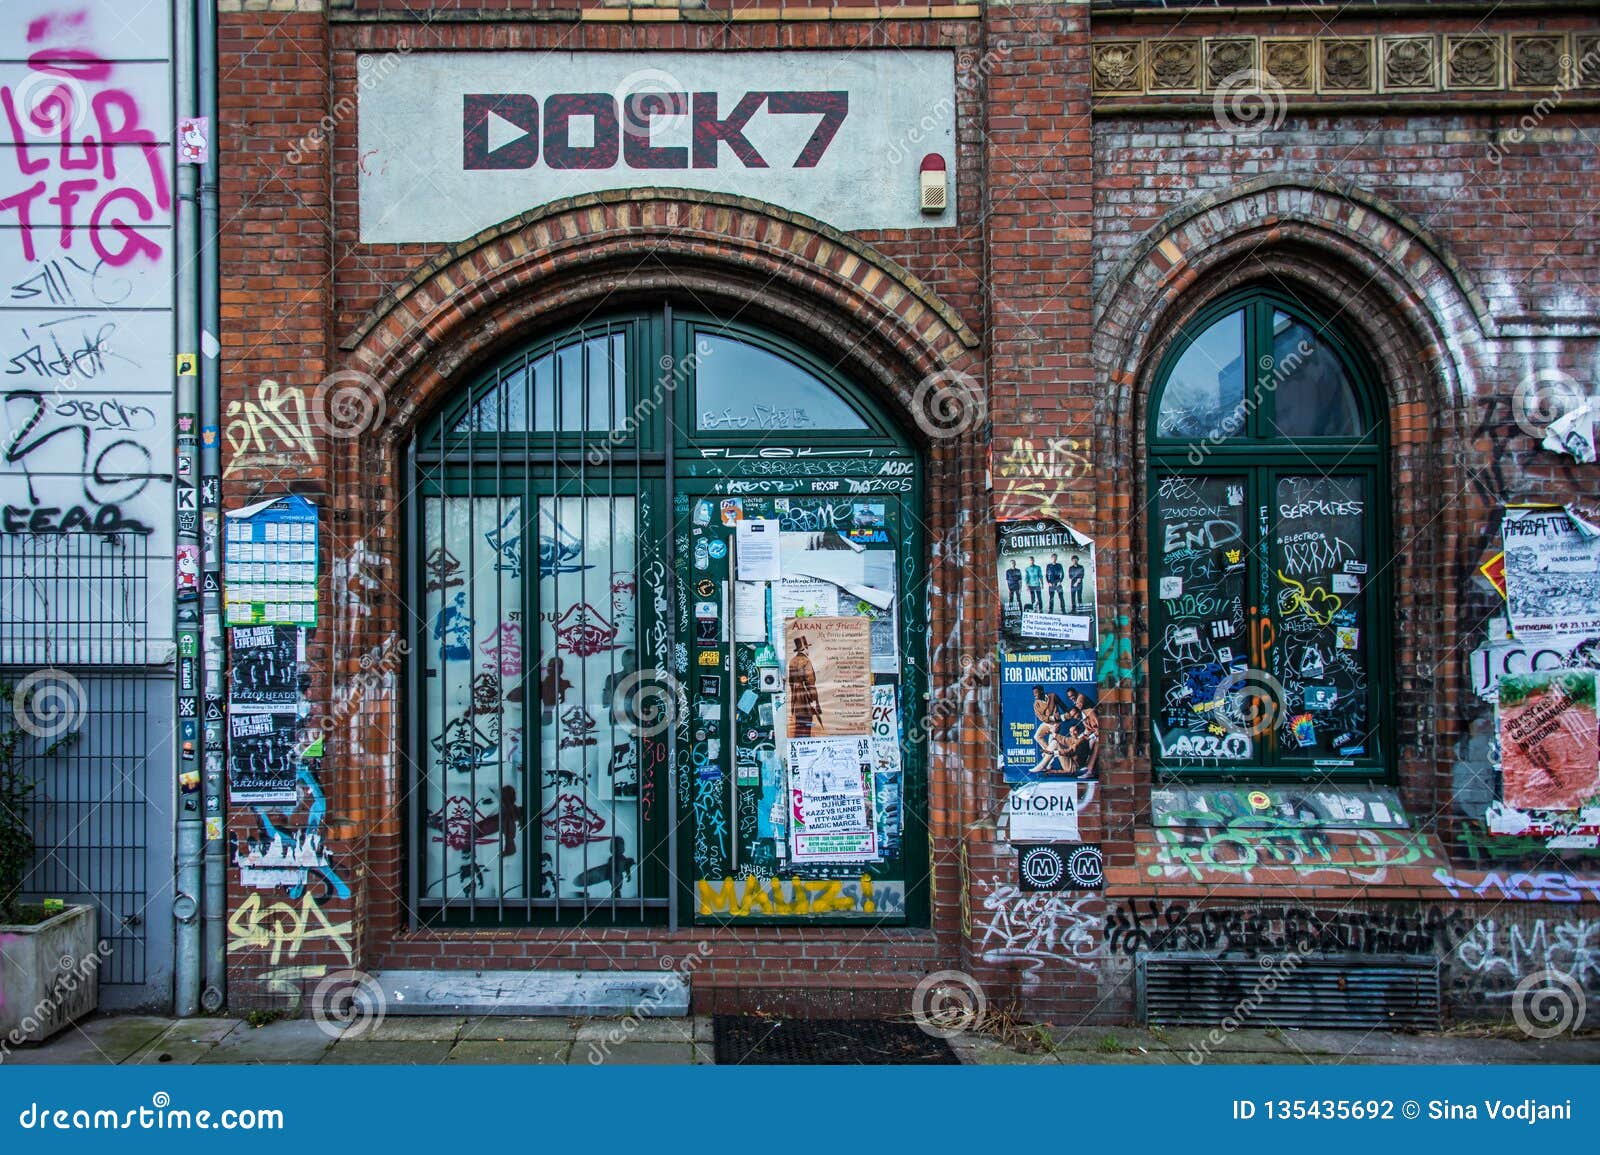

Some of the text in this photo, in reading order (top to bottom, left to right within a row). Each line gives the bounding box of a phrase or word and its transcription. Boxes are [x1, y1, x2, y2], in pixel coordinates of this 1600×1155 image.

[1164, 520, 1242, 553] END
[793, 621, 821, 631] ALKAN
[1005, 667, 1093, 682] FOR DANCERS ONLY
[806, 809, 826, 817] KAZZ
[833, 819, 860, 828] MARCEL
